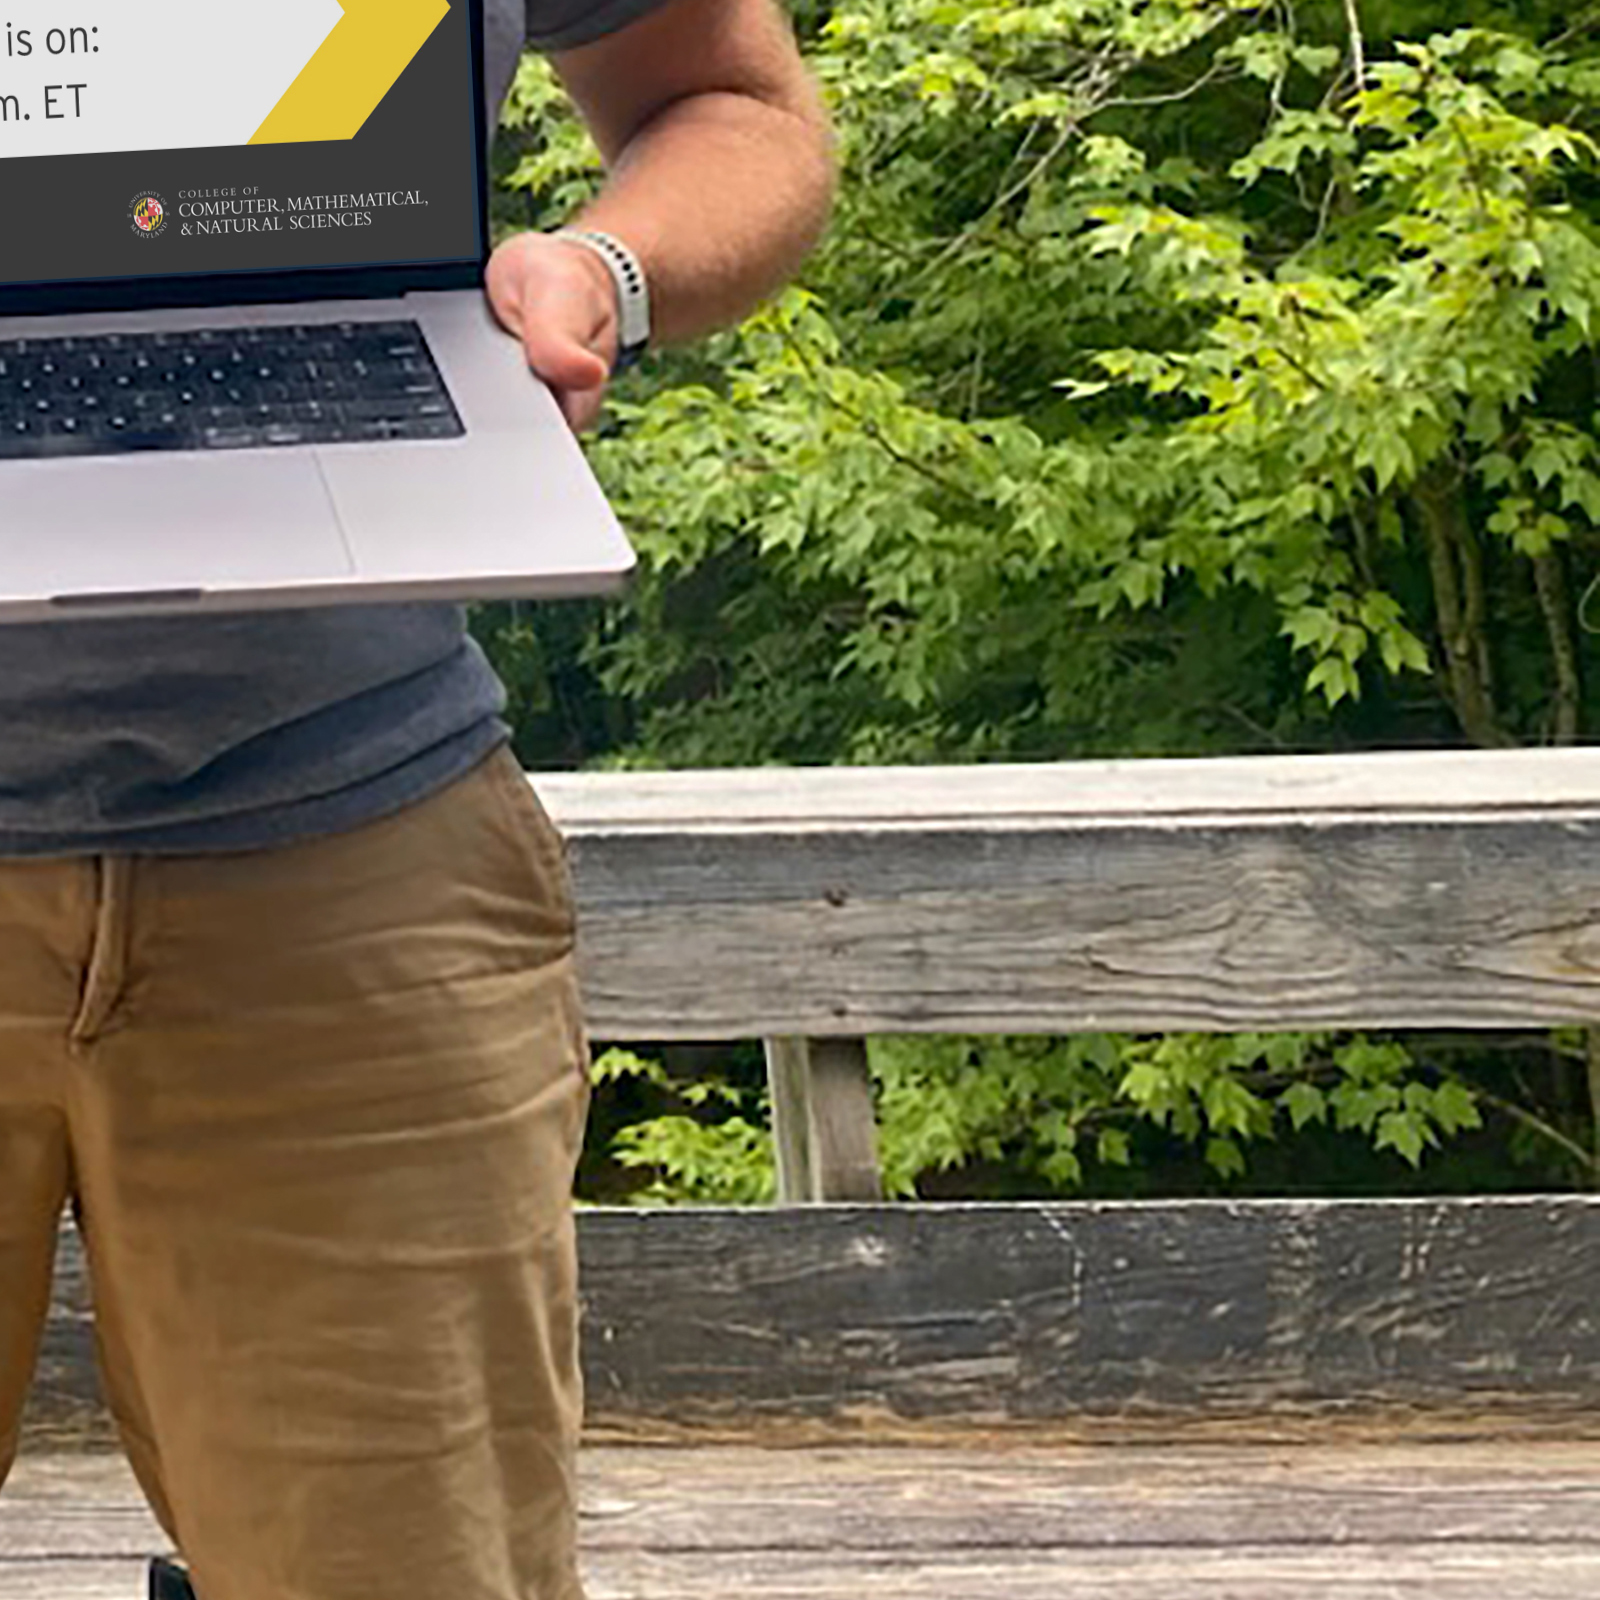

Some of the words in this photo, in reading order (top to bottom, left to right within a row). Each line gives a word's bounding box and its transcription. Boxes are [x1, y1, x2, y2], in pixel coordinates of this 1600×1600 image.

[6, 22, 33, 57] is
[45, 26, 99, 55] on:
[44, 83, 88, 119] ET
[178, 187, 237, 199] COLLEGE
[243, 186, 260, 196] OF
[178, 198, 285, 218] COMPUTER,
[287, 190, 429, 212] MATHEMATICAL,
[130, 222, 168, 239] MARYLAND
[180, 222, 193, 236] &
[196, 216, 283, 235] NATURAL
[289, 211, 372, 230] SCIENCES
